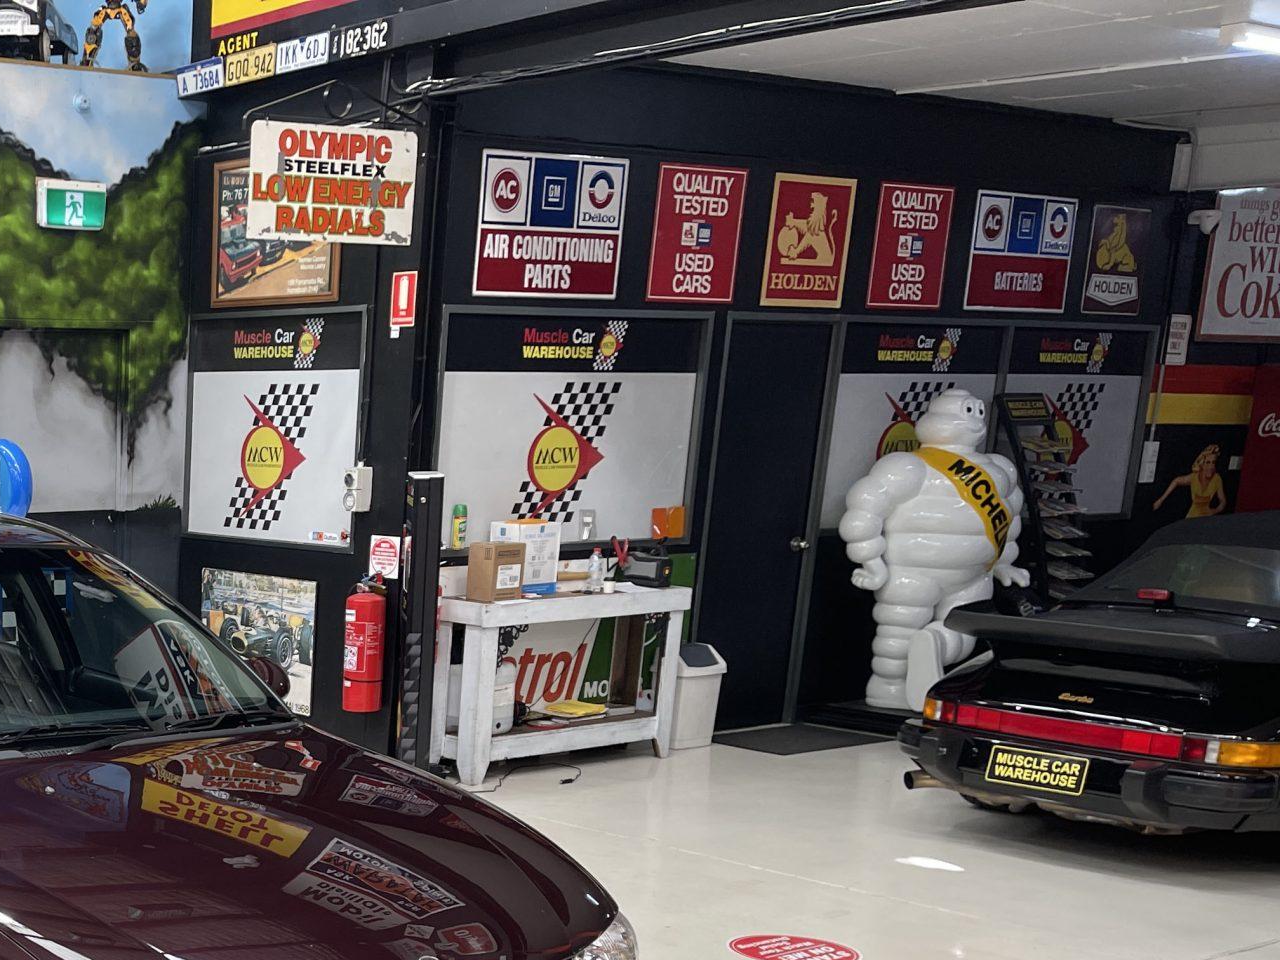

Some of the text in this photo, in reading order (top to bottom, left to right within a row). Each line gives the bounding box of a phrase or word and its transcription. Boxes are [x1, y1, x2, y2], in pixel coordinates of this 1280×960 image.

[218, 32, 259, 56] AGENT
[254, 52, 273, 75] 942
[182, 69, 220, 94] A 73684
[278, 128, 392, 164] OLYMPIC
[284, 159, 386, 178] STEELFLEX
[252, 173, 413, 209] LOW ENERGY
[495, 178, 517, 200] AC
[548, 184, 561, 198] GM
[673, 172, 735, 196] QUALITY
[674, 194, 728, 217] TESTED
[892, 190, 943, 211] QUALITY
[275, 205, 386, 237] RADIALS
[582, 212, 616, 224] Delco
[892, 210, 938, 230] TESTED
[984, 214, 1002, 231] AC
[484, 233, 614, 263] AIR CONDITIONING
[675, 253, 714, 273] USED
[891, 263, 925, 282] USED
[524, 264, 571, 290] PARTS
[672, 274, 711, 295] CARS
[770, 273, 838, 292] HOLDEN
[994, 272, 1043, 293] BATTERIES
[889, 283, 922, 301] CARS
[1093, 280, 1133, 296] HOLDEN
[235, 328, 295, 344] Muscle Car
[524, 328, 595, 344] Muscle Car
[917, 334, 936, 349] Car
[1073, 339, 1090, 352] Car
[234, 346, 294, 359] WAREHOUSE
[523, 345, 594, 359] WAREHOUSE
[877, 350, 934, 362] WAREHOUSE
[1039, 352, 1088, 364] WAREHOUSE
[247, 446, 282, 463] MCW
[535, 446, 578, 464] MCW
[997, 752, 1080, 776] MUSCLE CAR
[995, 766, 1077, 789] WAREHOUSE
